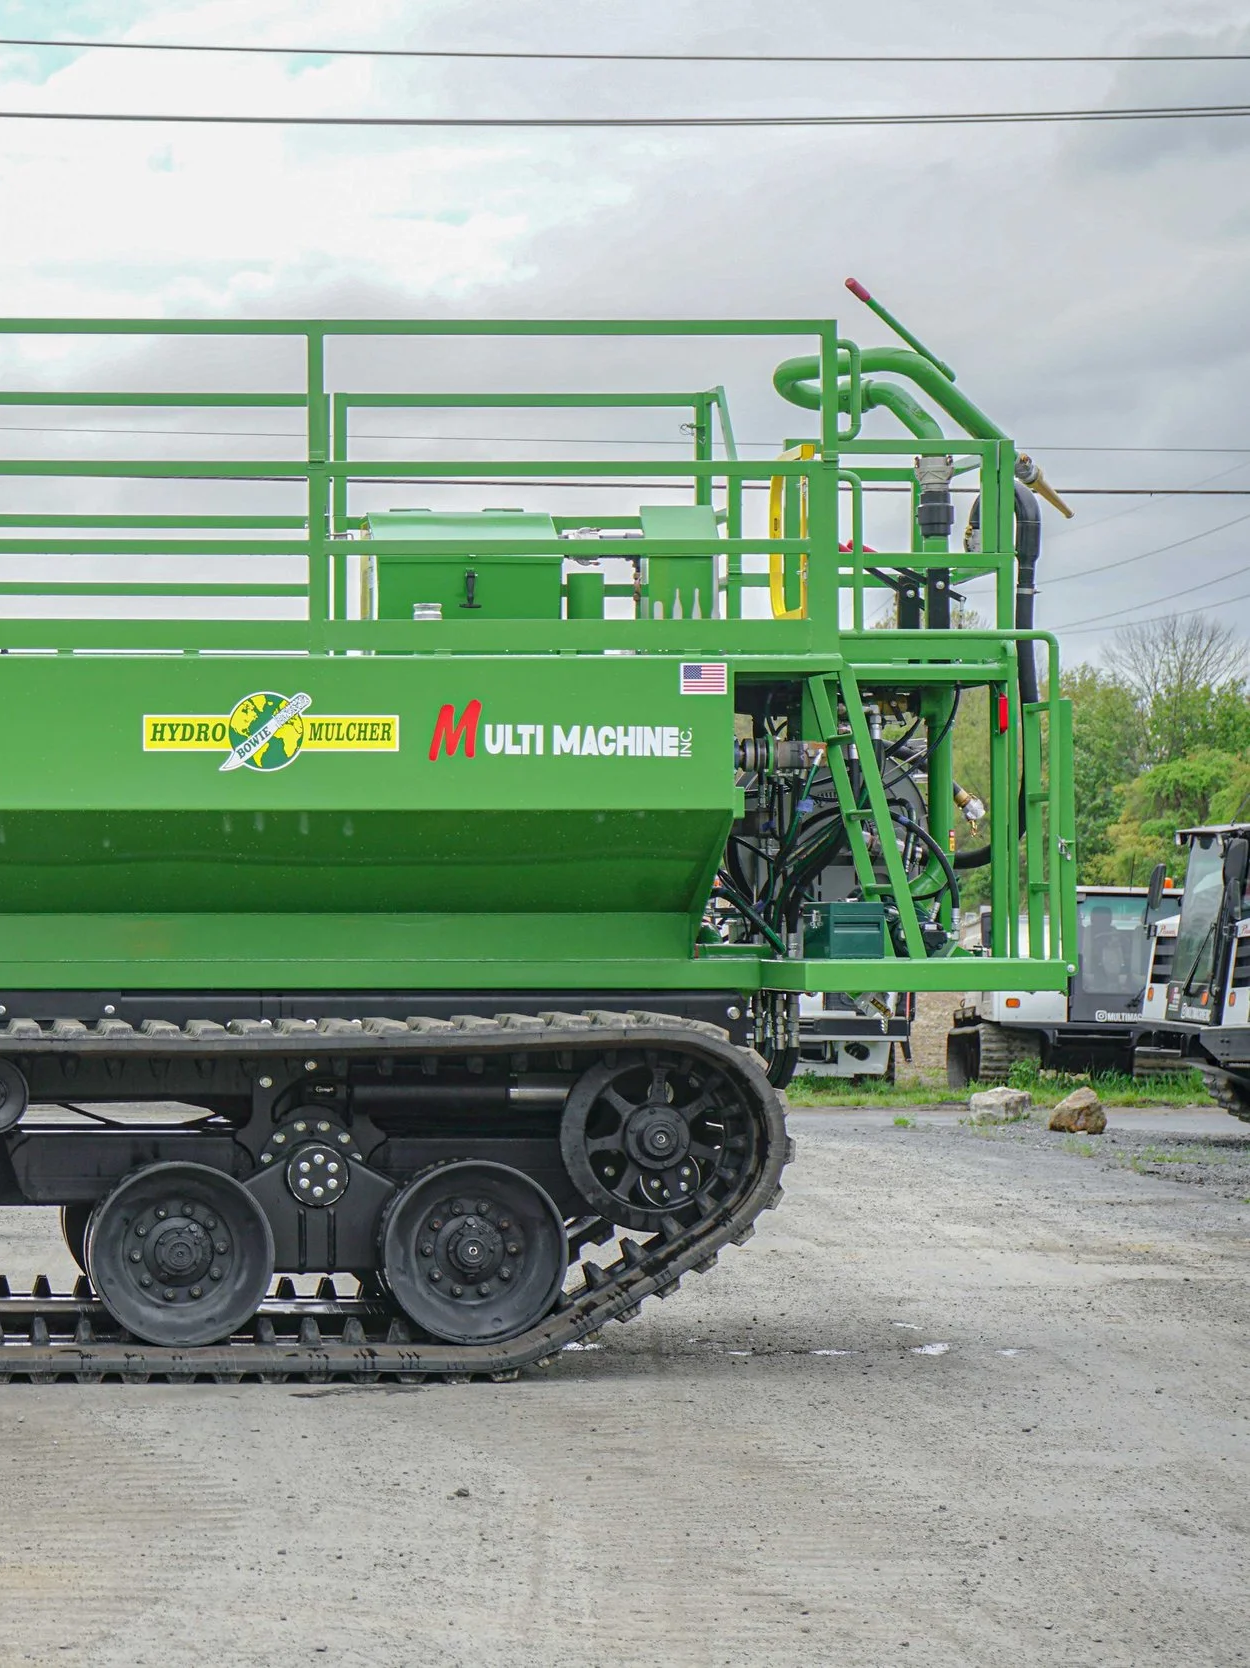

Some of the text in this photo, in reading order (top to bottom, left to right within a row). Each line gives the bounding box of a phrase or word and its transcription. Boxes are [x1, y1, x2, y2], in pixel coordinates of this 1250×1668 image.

[150, 722, 392, 759] HYDRO BOWIE MULCHER
[429, 699, 544, 762] MULTI
[553, 725, 679, 757] MACHINE
